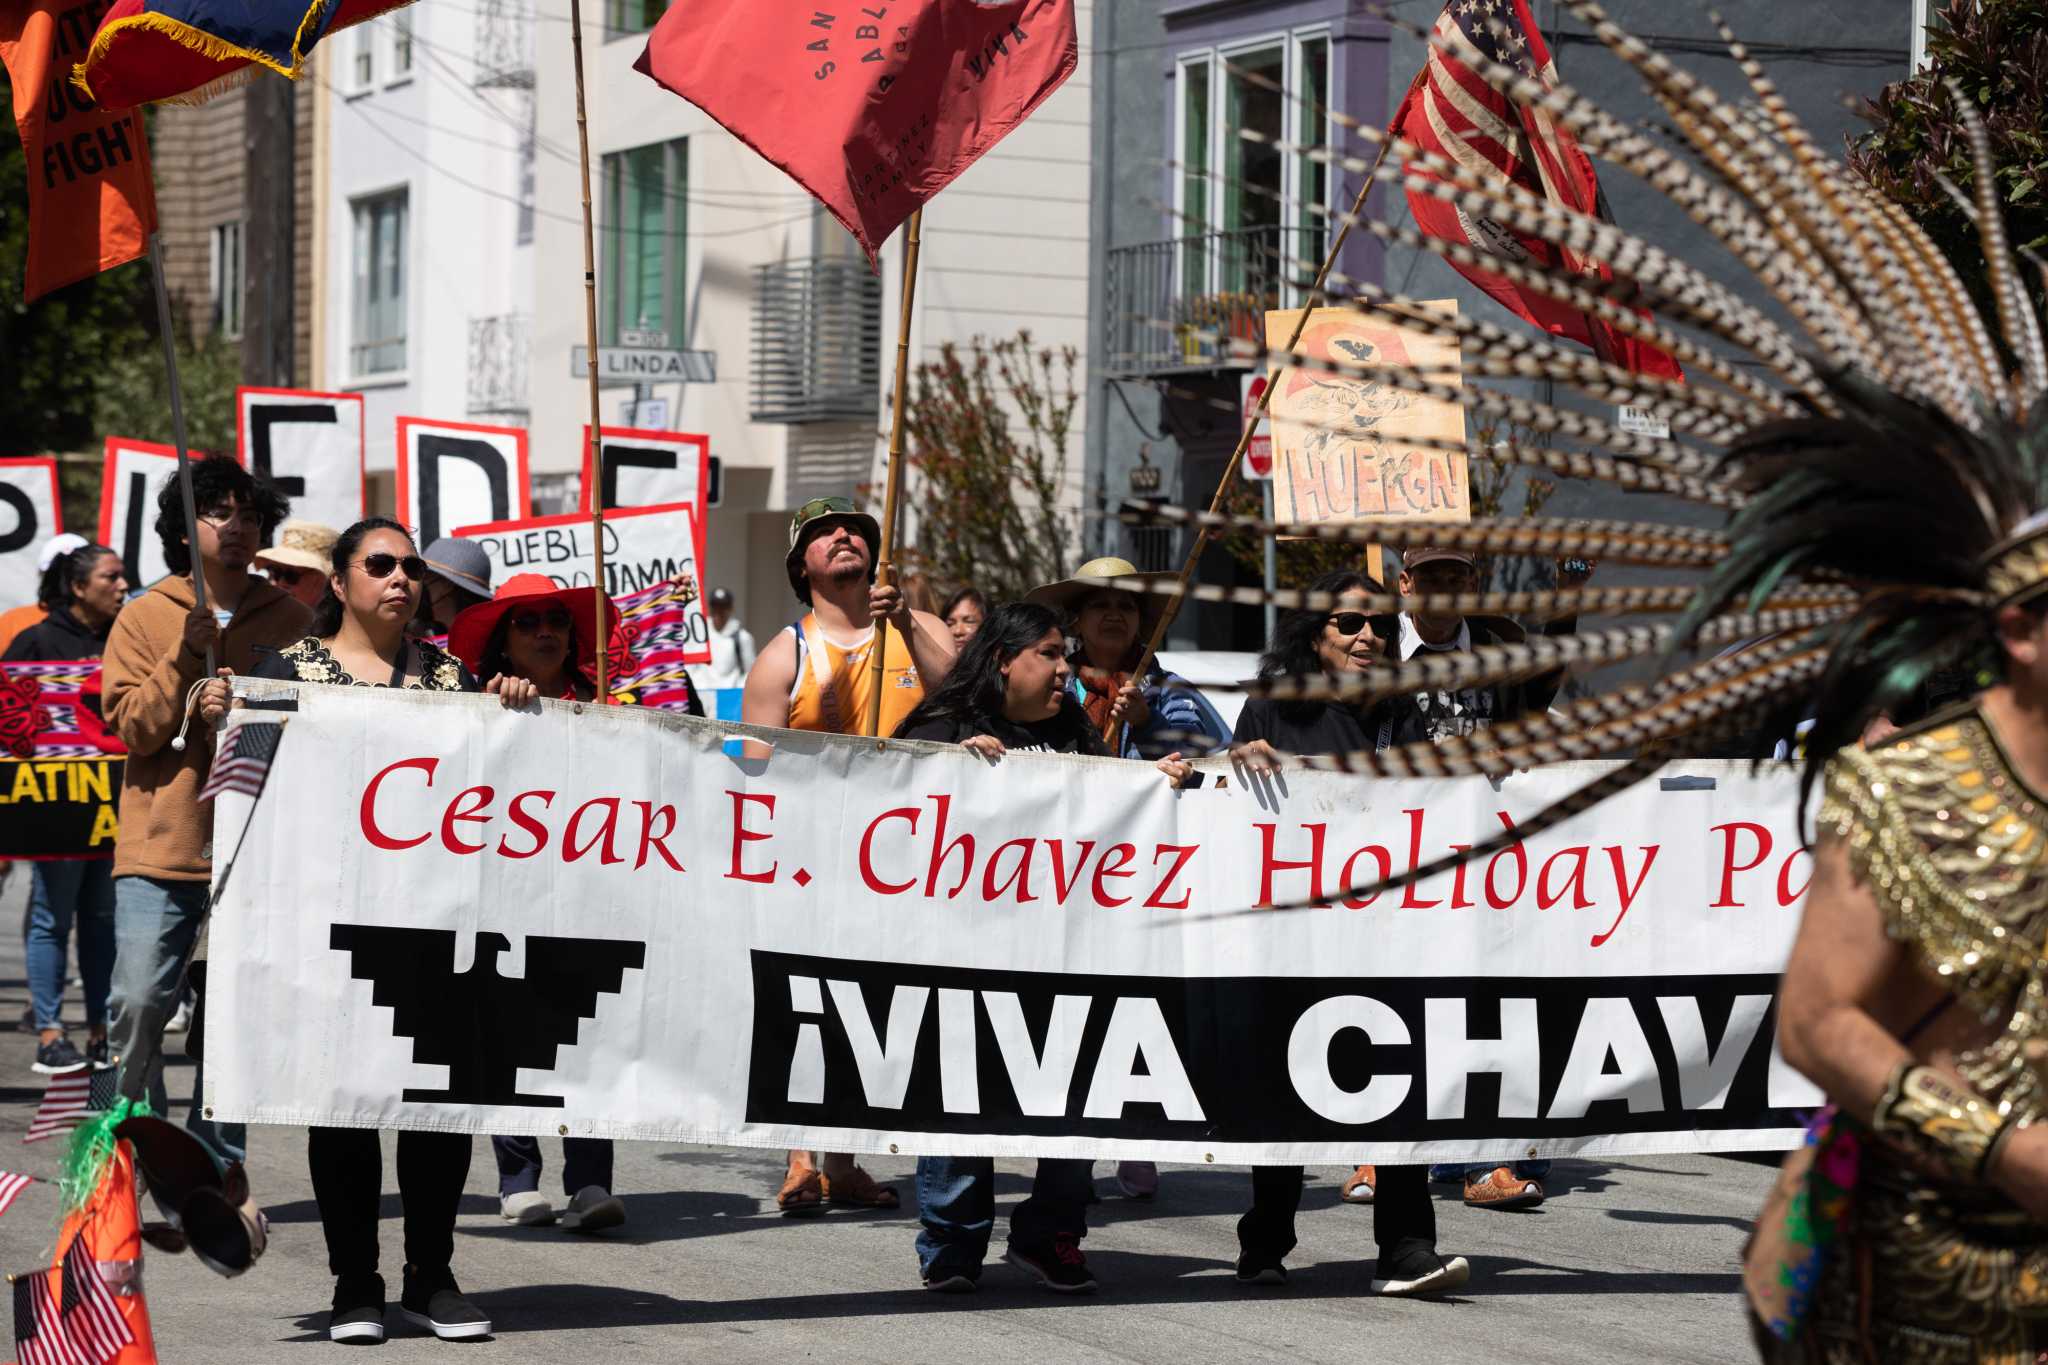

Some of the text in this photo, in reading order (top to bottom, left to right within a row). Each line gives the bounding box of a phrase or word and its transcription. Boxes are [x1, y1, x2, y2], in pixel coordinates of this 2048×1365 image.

[806, 11, 836, 80] SAN
[969, 21, 1028, 82] VIVA
[608, 354, 683, 374] LINDA
[479, 522, 620, 568] PUEBLO
[359, 757, 686, 873] Cesar
[723, 789, 812, 888] E.
[858, 794, 1200, 910] Chavez
[1251, 807, 1660, 948] Holiday
[787, 974, 1206, 1121] ¡VIVA
